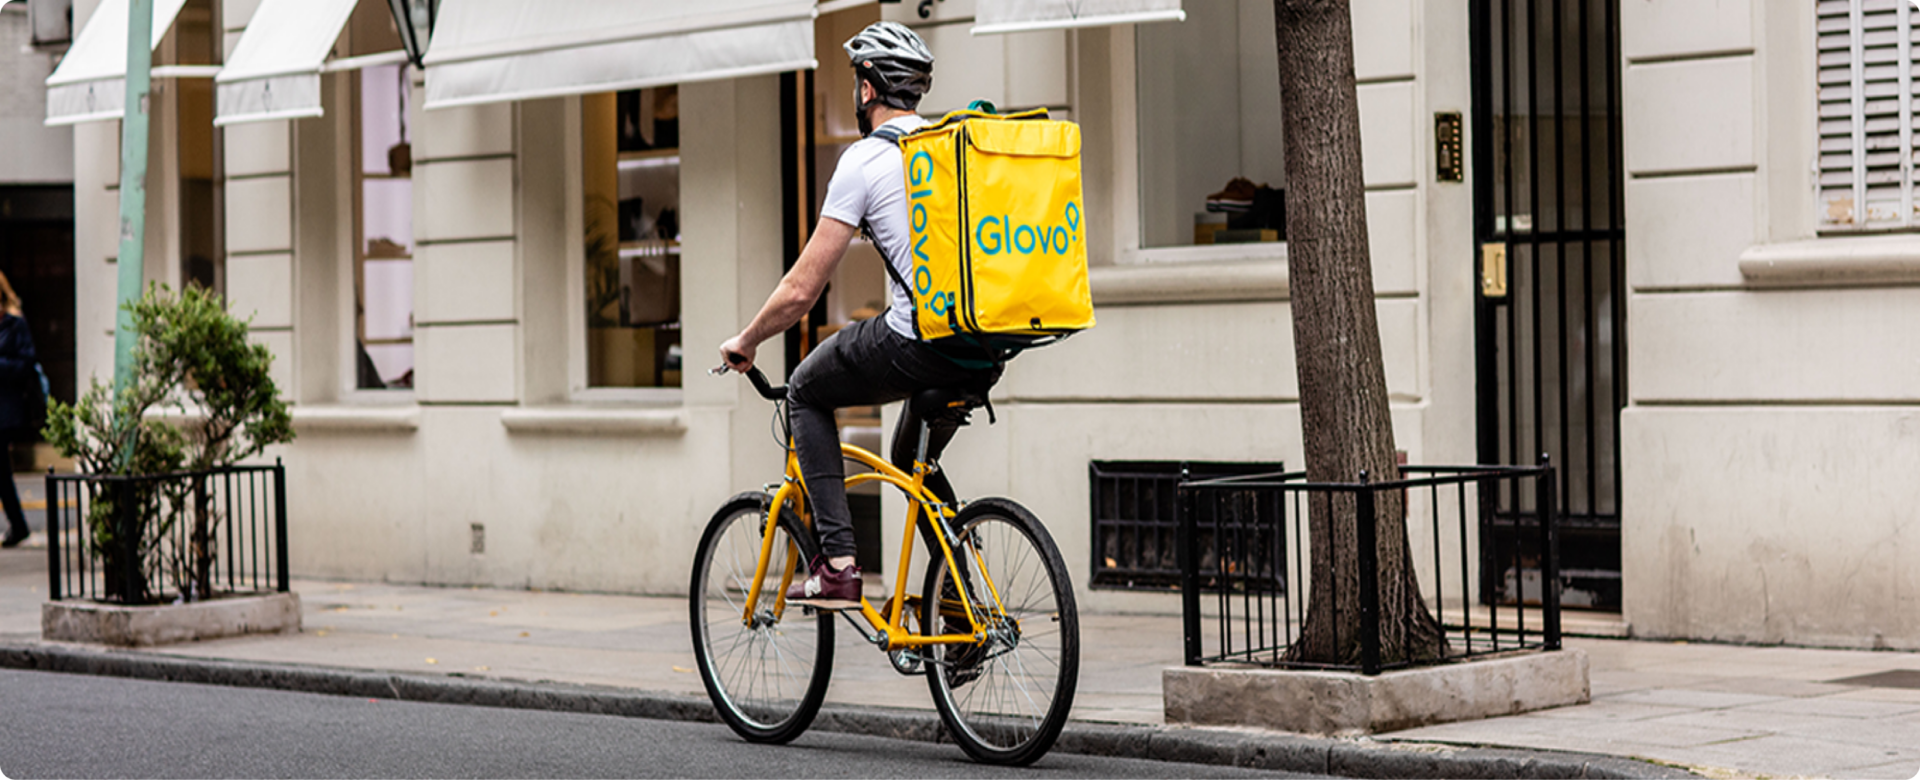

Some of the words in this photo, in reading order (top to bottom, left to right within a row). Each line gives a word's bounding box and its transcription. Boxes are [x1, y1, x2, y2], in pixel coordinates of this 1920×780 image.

[909, 151, 934, 296] Glovo
[976, 214, 1069, 255] Glovo
[804, 575, 822, 598] N
